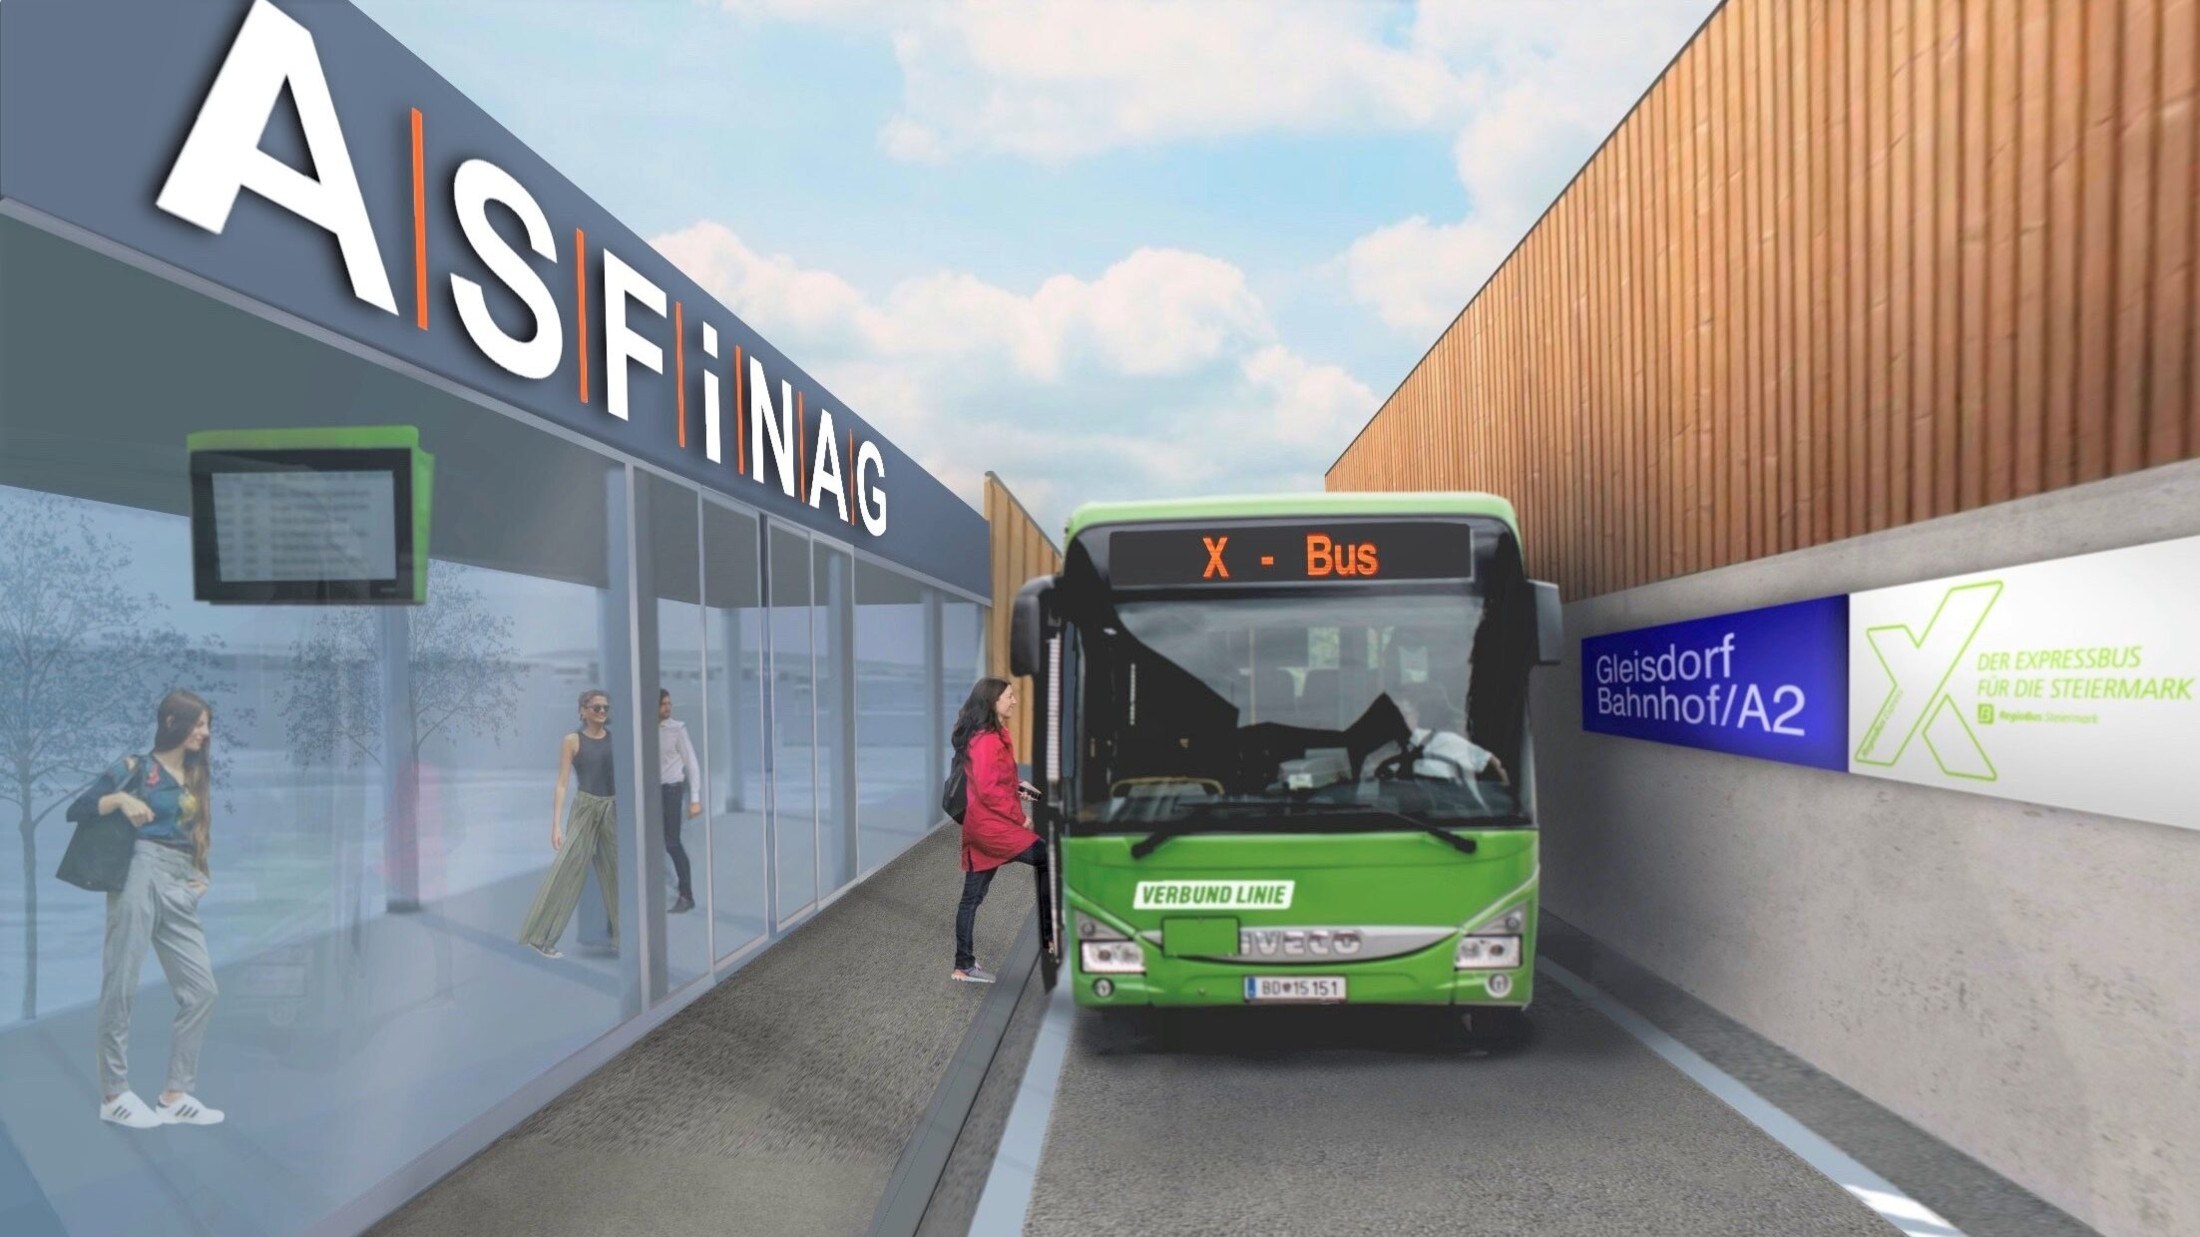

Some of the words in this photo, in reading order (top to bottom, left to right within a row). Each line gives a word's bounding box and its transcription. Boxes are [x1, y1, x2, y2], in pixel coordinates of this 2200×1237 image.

[1202, 536, 1230, 578] X
[1260, 555, 1274, 565] -
[1306, 534, 1378, 577] Bus
[1596, 632, 1735, 684] Gleisdorf
[1977, 653, 2010, 671] DER
[2015, 646, 2142, 670] EXPRESSBUS
[1977, 676, 2010, 697] FÜR
[2014, 678, 2044, 698] DIE
[2050, 677, 2195, 700] STEIERMARK
[1598, 683, 1805, 736] Bahnhof/A2
[1142, 885, 1233, 904] VERBUND
[1235, 885, 1287, 904] LINIE
